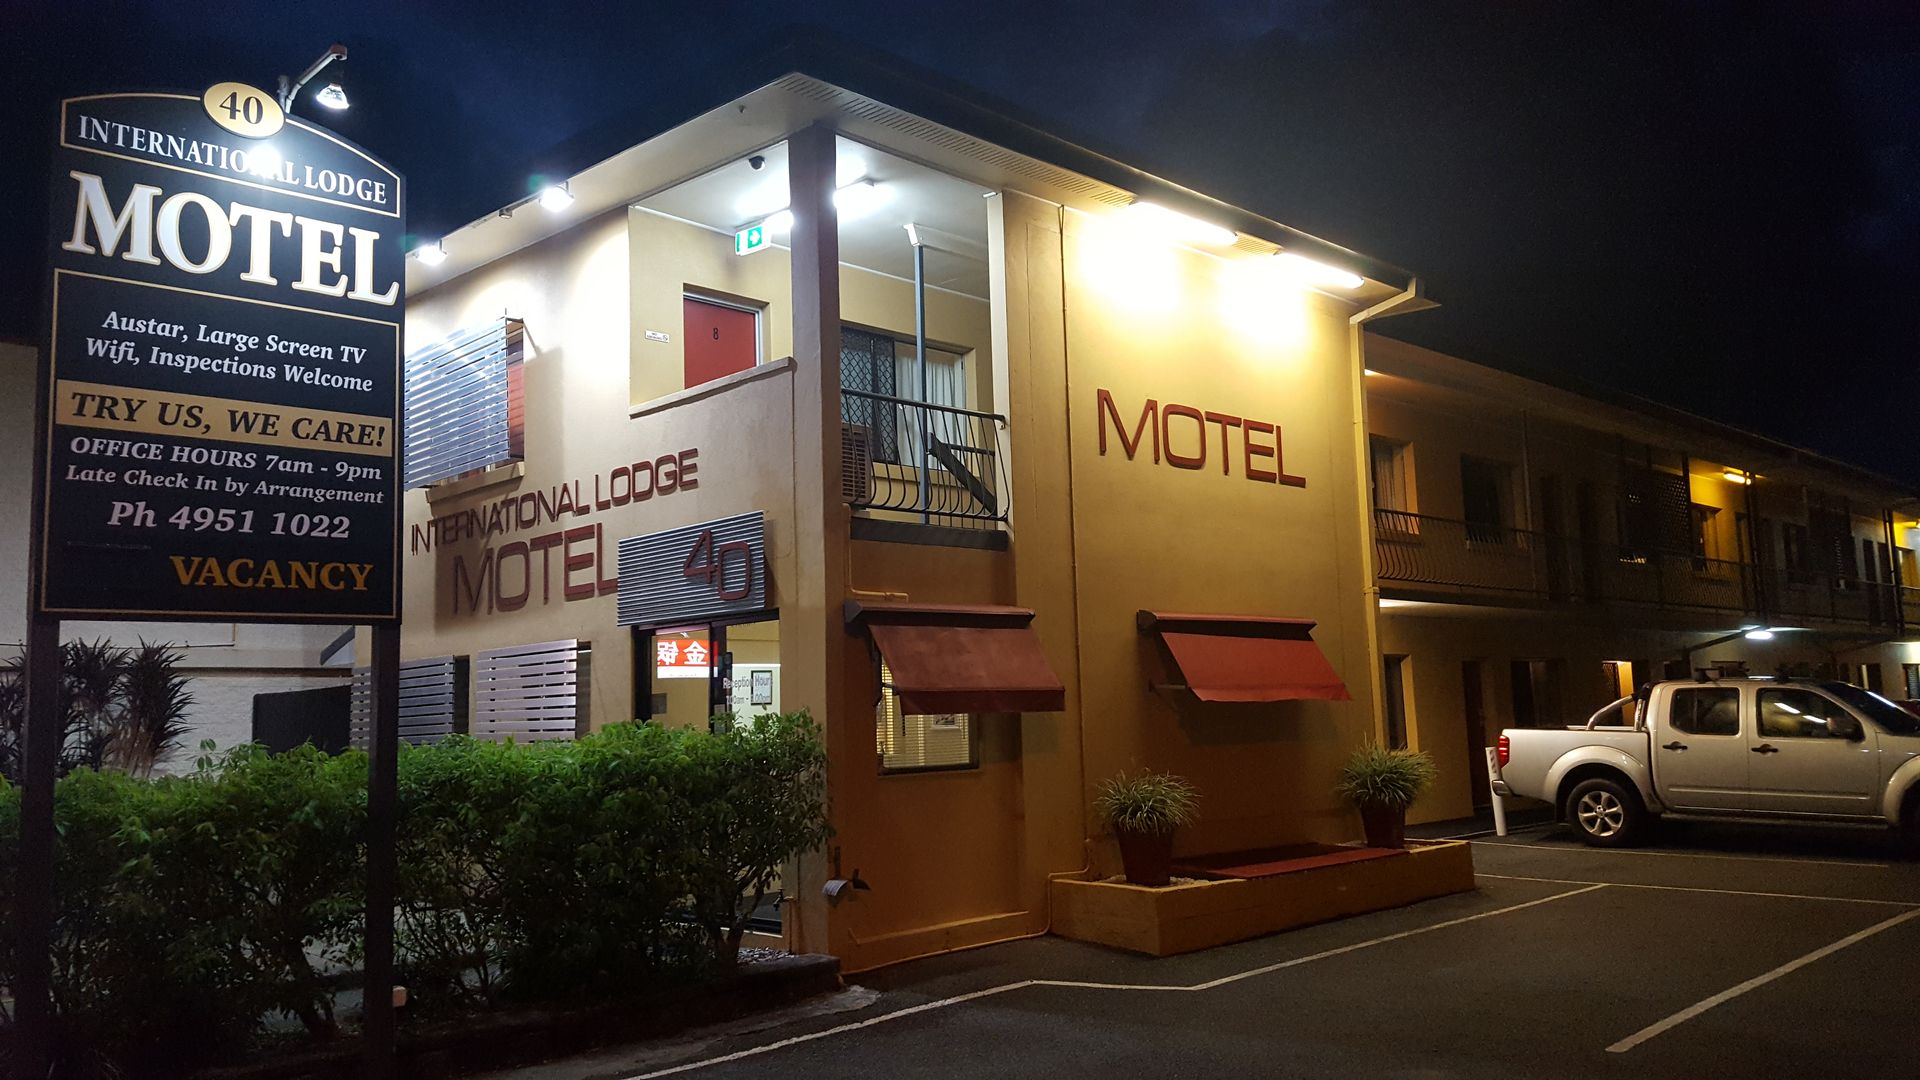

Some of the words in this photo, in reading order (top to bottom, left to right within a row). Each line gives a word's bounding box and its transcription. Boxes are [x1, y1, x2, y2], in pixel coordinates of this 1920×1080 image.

[218, 92, 264, 125] 40
[79, 115, 299, 185] INTERNATIOAL
[304, 164, 387, 204] LODGE
[62, 170, 400, 306] MOTEL
[101, 311, 189, 343] Austar,
[196, 324, 260, 351] Large
[265, 334, 334, 360] Screen
[340, 345, 367, 364] TV
[712, 327, 720, 340] 8
[86, 337, 140, 366] Wifi,
[149, 346, 277, 379] Inspections
[283, 364, 373, 392] Welcome
[71, 392, 147, 422] TRY
[158, 401, 211, 435] US,
[227, 409, 281, 437] WE
[291, 417, 386, 447] CARE!
[1096, 388, 1307, 489] MOTEL
[65, 464, 117, 483] Late
[123, 469, 190, 489] Check
[194, 475, 218, 492] In
[224, 477, 250, 497] by
[253, 480, 385, 504] Arrangement
[70, 436, 164, 461] OFFICE
[169, 445, 257, 469] HOURS
[265, 454, 314, 474] 7am
[334, 461, 383, 482] 9pm
[107, 501, 158, 529] Ph
[168, 505, 254, 533] 4951
[270, 512, 351, 539] 1022
[411, 479, 591, 556] INTERNATIONAL
[594, 448, 700, 512] LODGE
[169, 555, 374, 591] VACANCY
[453, 522, 618, 616] MOTEL
[683, 529, 752, 601] 40
